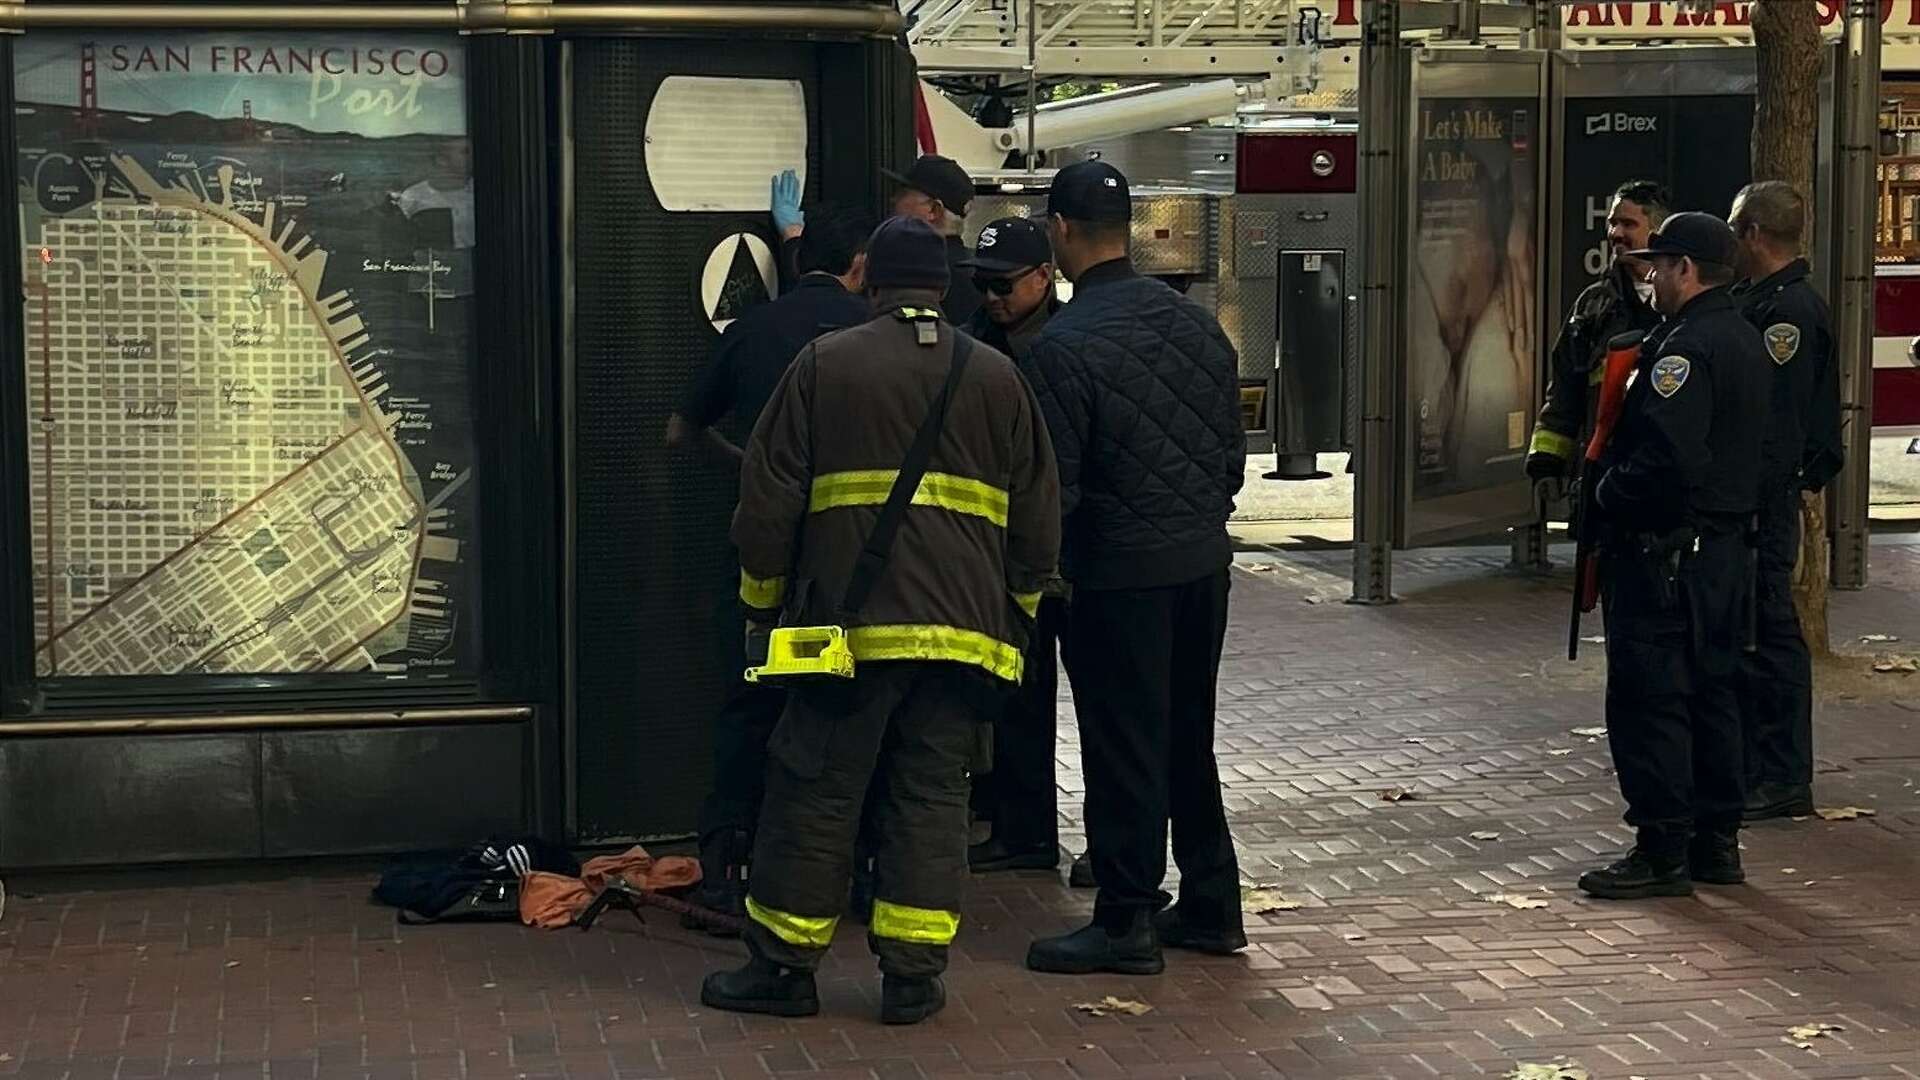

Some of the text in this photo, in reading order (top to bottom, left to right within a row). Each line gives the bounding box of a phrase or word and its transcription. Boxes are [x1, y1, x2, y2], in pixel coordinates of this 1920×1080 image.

[111, 45, 449, 77] SAN FRANCISCO
[309, 62, 423, 119] Port
[1424, 111, 1503, 140] Let's Make
[1614, 113, 1656, 132] Brex
[1422, 152, 1477, 189] A Baby
